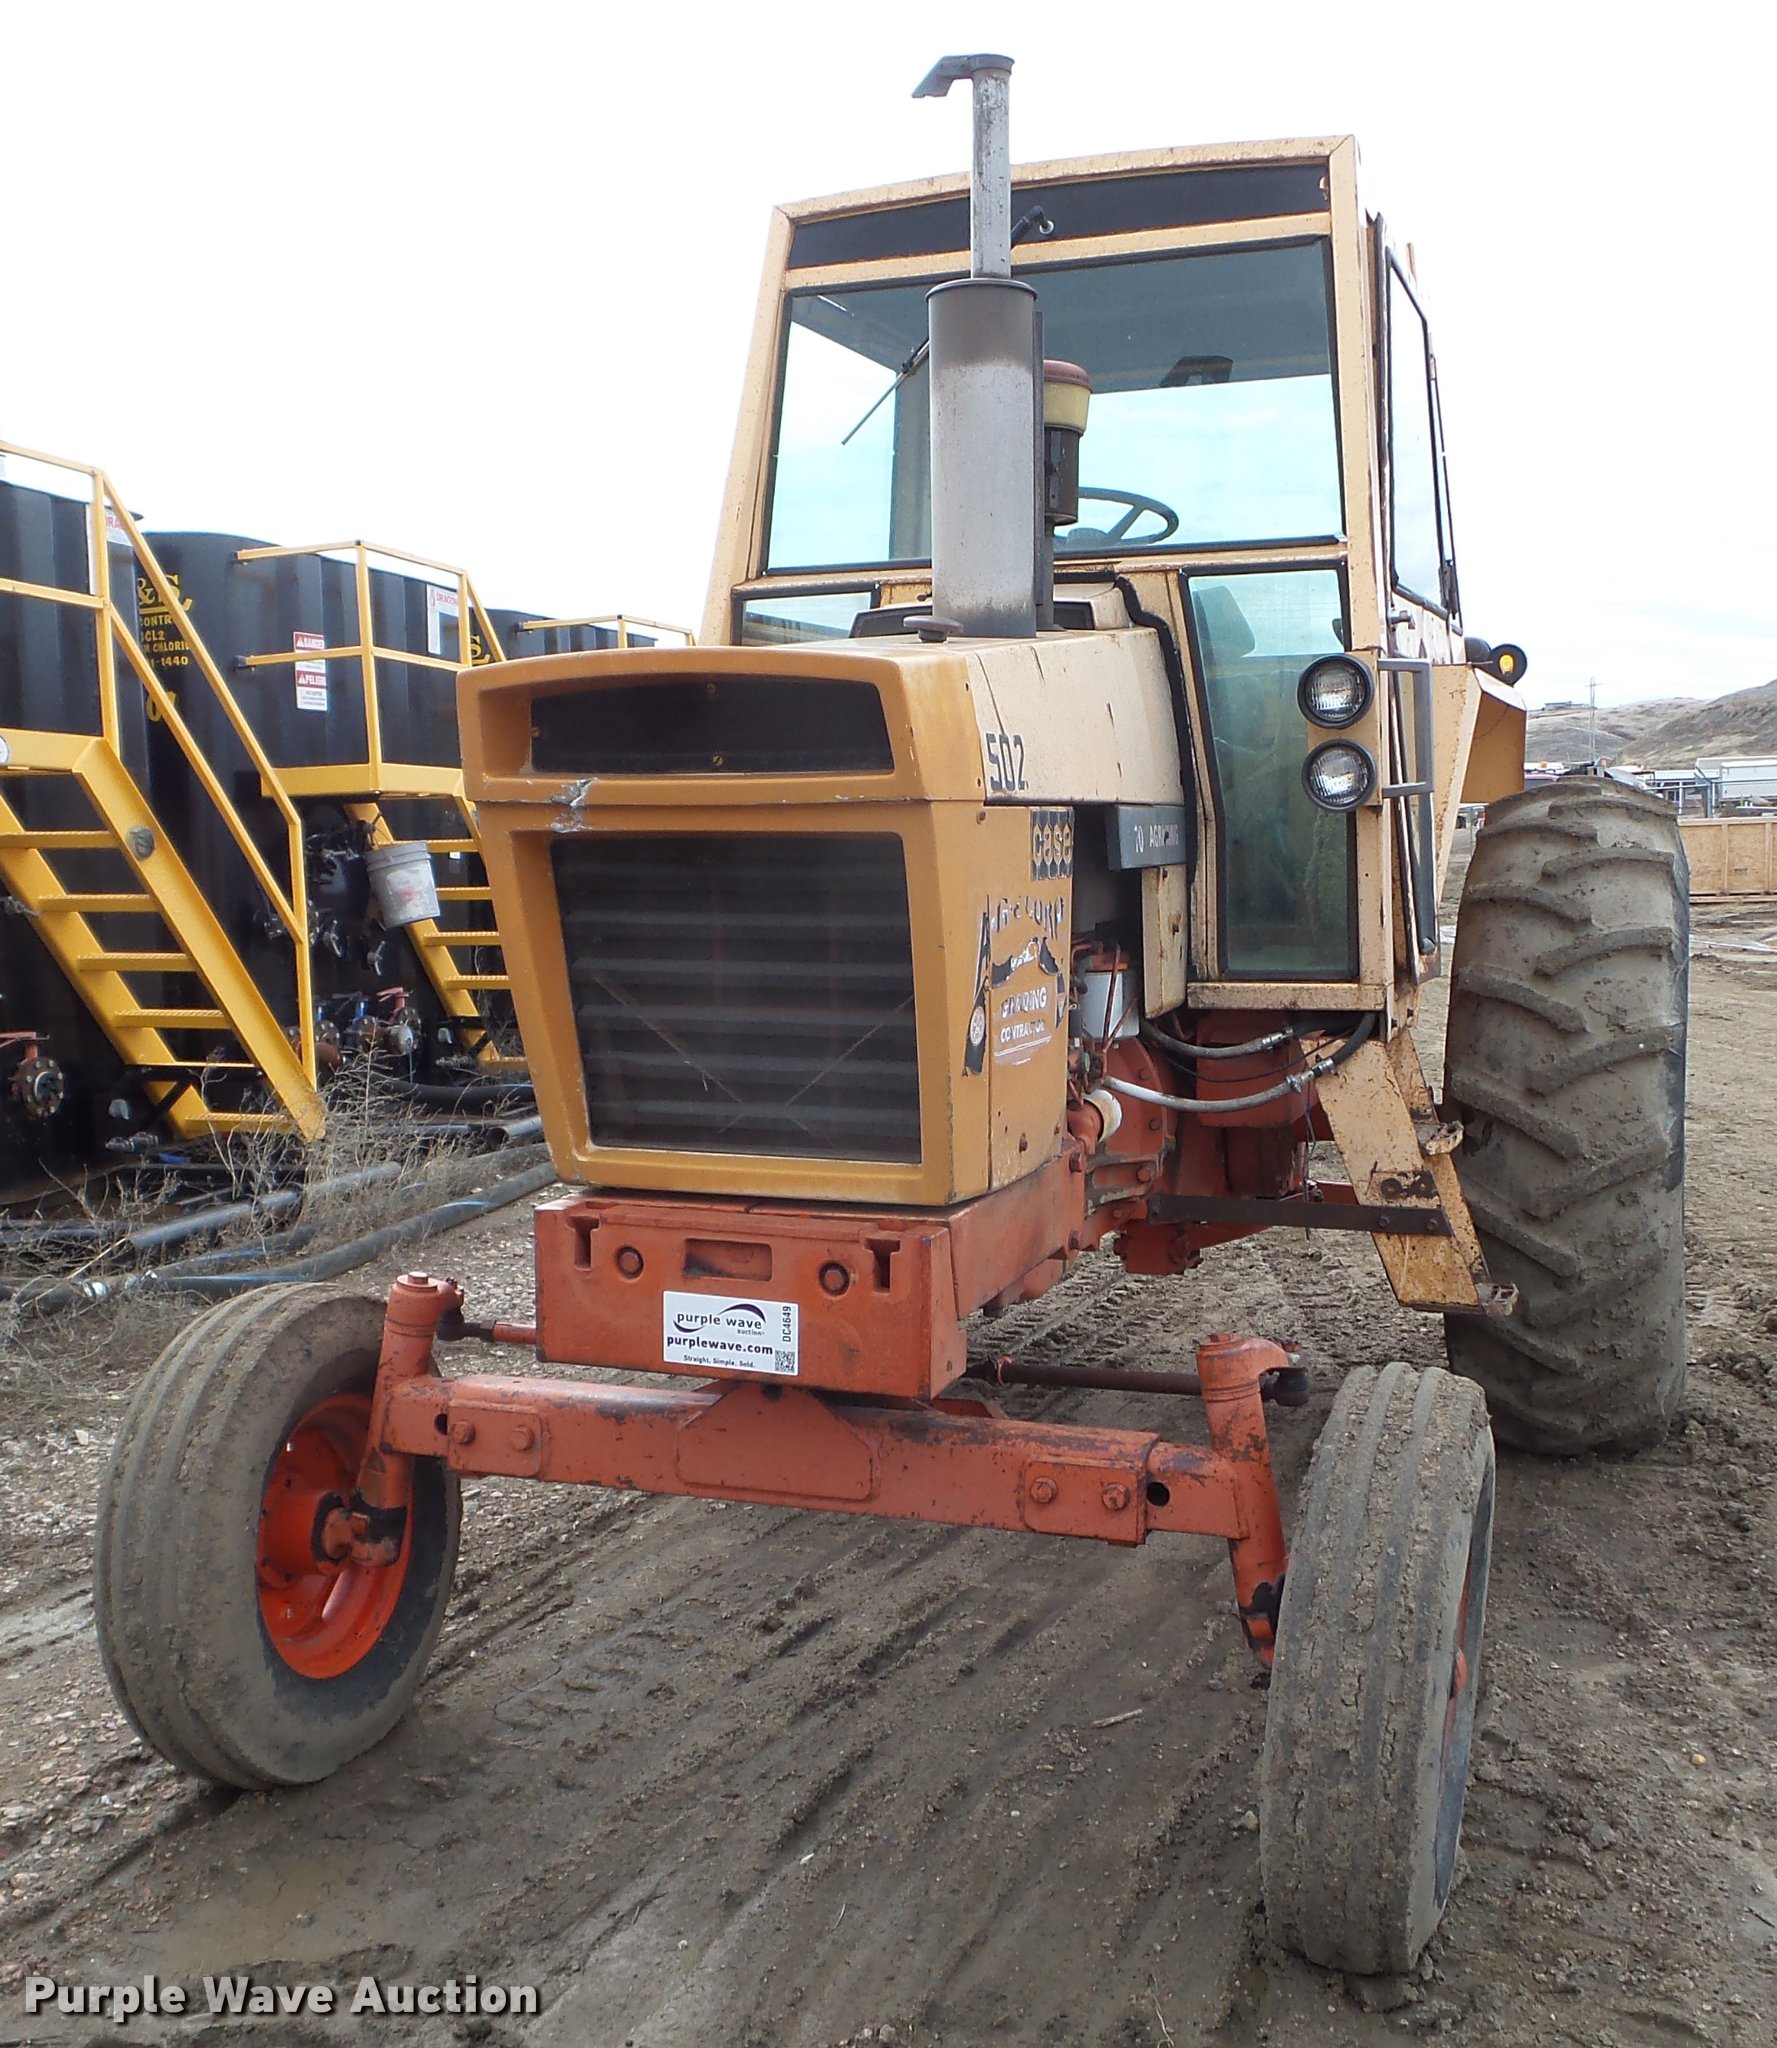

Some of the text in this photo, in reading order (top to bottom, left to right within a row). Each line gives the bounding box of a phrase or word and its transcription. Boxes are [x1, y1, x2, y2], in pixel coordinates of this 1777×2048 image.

[677, 1312, 762, 1329] purple wave
[782, 1306, 792, 1342] DC4649
[667, 1336, 773, 1355] purplewave.com
